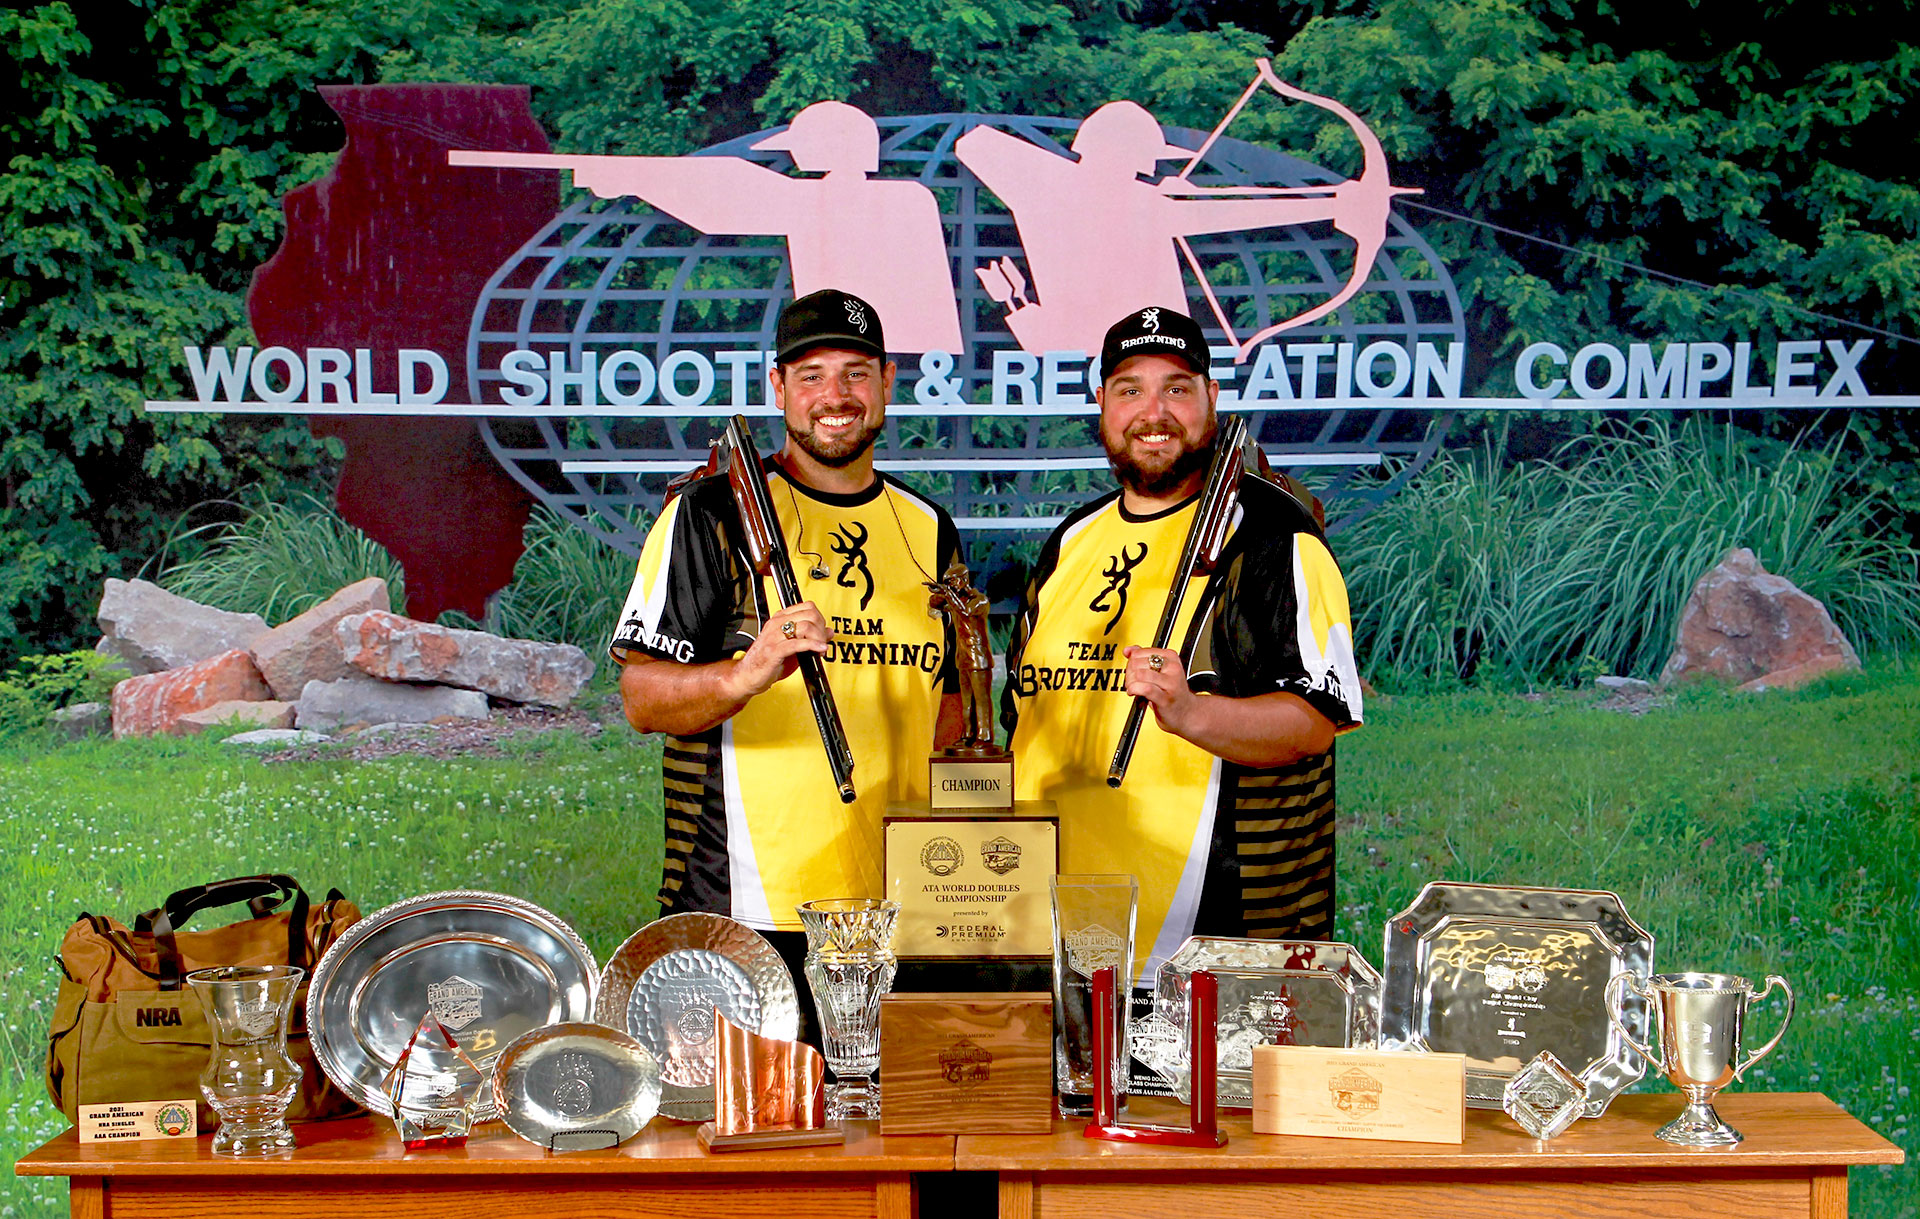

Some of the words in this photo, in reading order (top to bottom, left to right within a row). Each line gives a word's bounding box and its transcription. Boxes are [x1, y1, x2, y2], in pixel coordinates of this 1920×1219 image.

[1121, 335, 1187, 350] BROWNING
[183, 346, 450, 405] WORLD
[500, 350, 780, 405] SHOOTI
[914, 350, 963, 405] &
[992, 341, 1465, 405] REEATION
[1514, 339, 1875, 399] COMPLEX
[832, 616, 884, 636] TEAM
[618, 623, 695, 664] WNING
[1069, 642, 1118, 661] TEAM
[823, 641, 941, 673] OWNING
[1020, 664, 1127, 697] BROWNI
[941, 779, 1001, 792] CHAMPION
[922, 884, 940, 893] ATA
[942, 884, 976, 893] WORLD
[978, 884, 1021, 893] DOUBLES
[935, 895, 1007, 903] CHAMPIONSHIP
[1066, 936, 1090, 949] GRAND
[1091, 935, 1124, 948] AMERICAN
[136, 1007, 183, 1027] NRA
